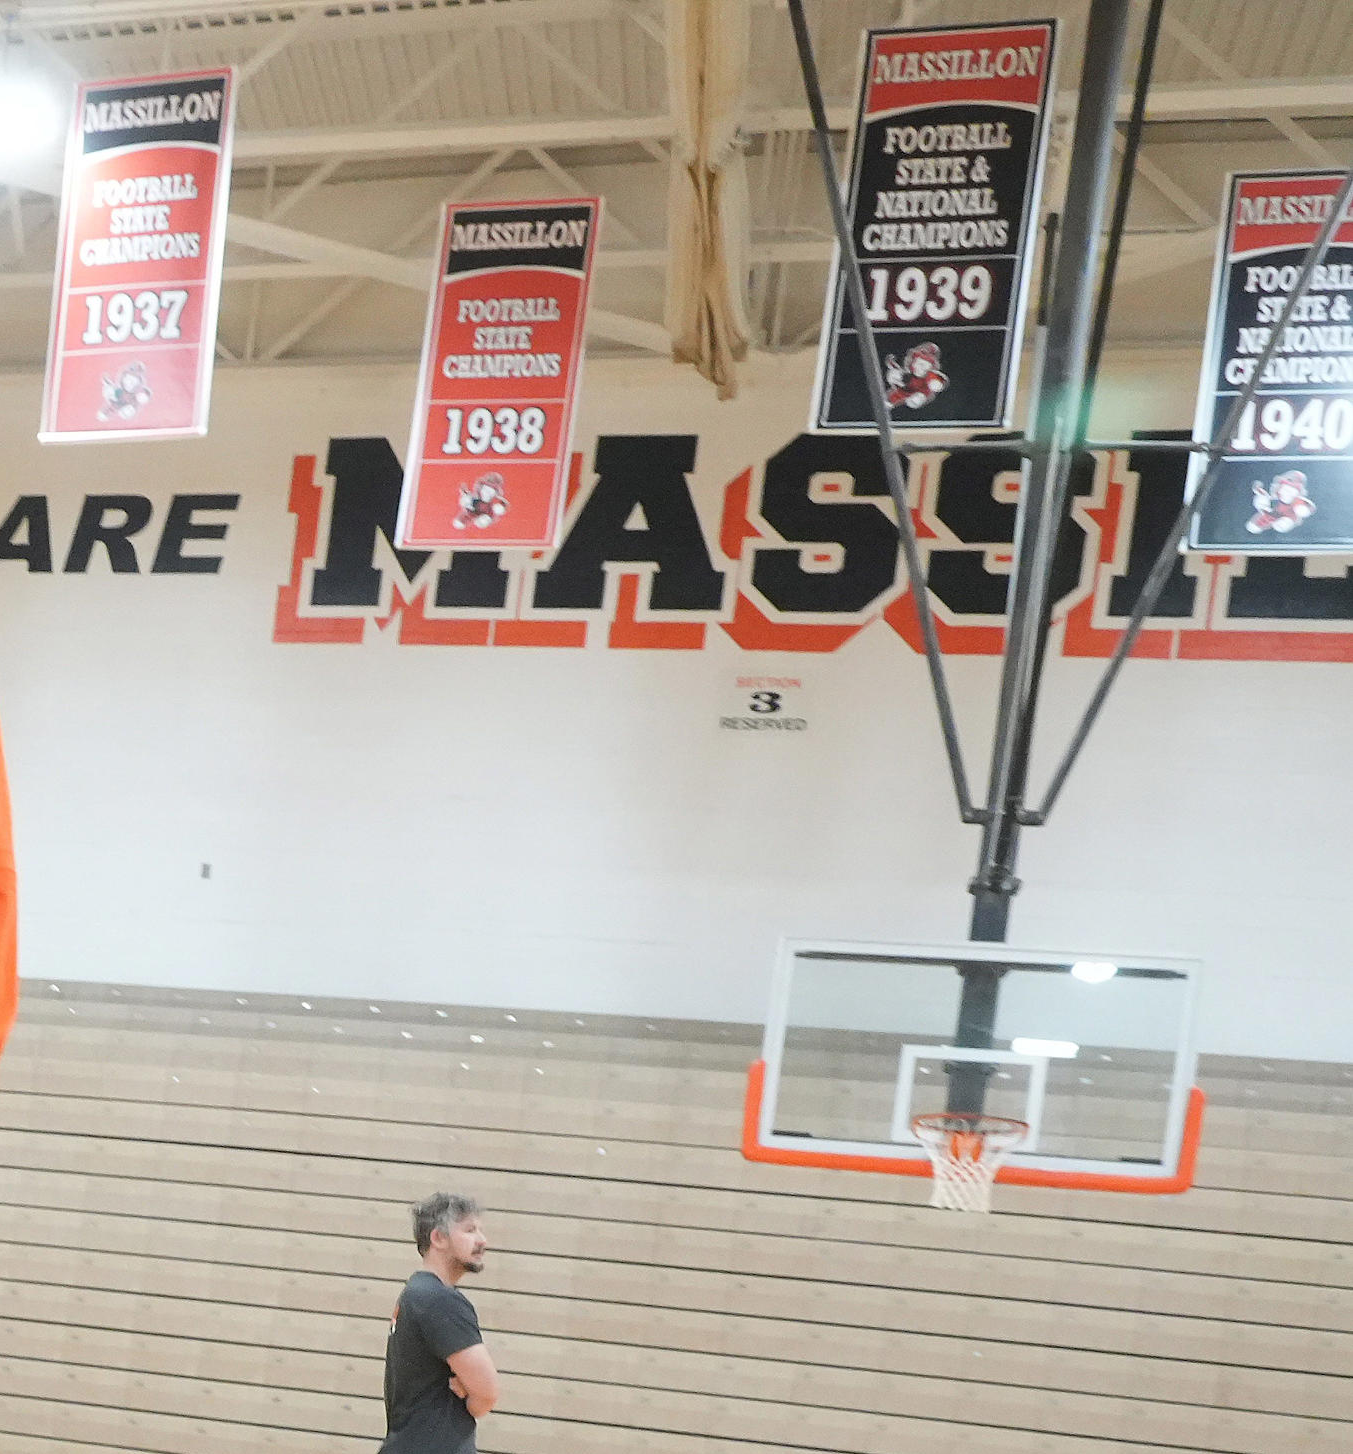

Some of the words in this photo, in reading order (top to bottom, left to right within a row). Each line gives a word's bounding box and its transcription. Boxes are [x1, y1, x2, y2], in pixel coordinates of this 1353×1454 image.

[874, 46, 1042, 85] MASSILLON
[84, 90, 222, 133] MASSILLON
[883, 123, 1012, 155] FOOTBALL
[895, 158, 968, 185] STATE
[969, 155, 991, 183] &
[93, 174, 198, 207] FOOTBALL
[875, 189, 997, 219] NATIONAL
[110, 205, 171, 234] STATE
[451, 220, 588, 251] MASSILLON
[80, 232, 201, 266] CHAMPIONS
[862, 220, 1009, 252] CHAMPIONS
[865, 265, 993, 322] 1939
[82, 290, 189, 346] 1937
[457, 297, 560, 323] FOOTBALL
[473, 326, 533, 350] STATE
[443, 353, 561, 378] CHAMPIONS
[442, 407, 545, 455] 1938
[1231, 399, 1353, 450] 1940
[289, 433, 1353, 640] MASSI
[749, 691, 782, 714] 3
